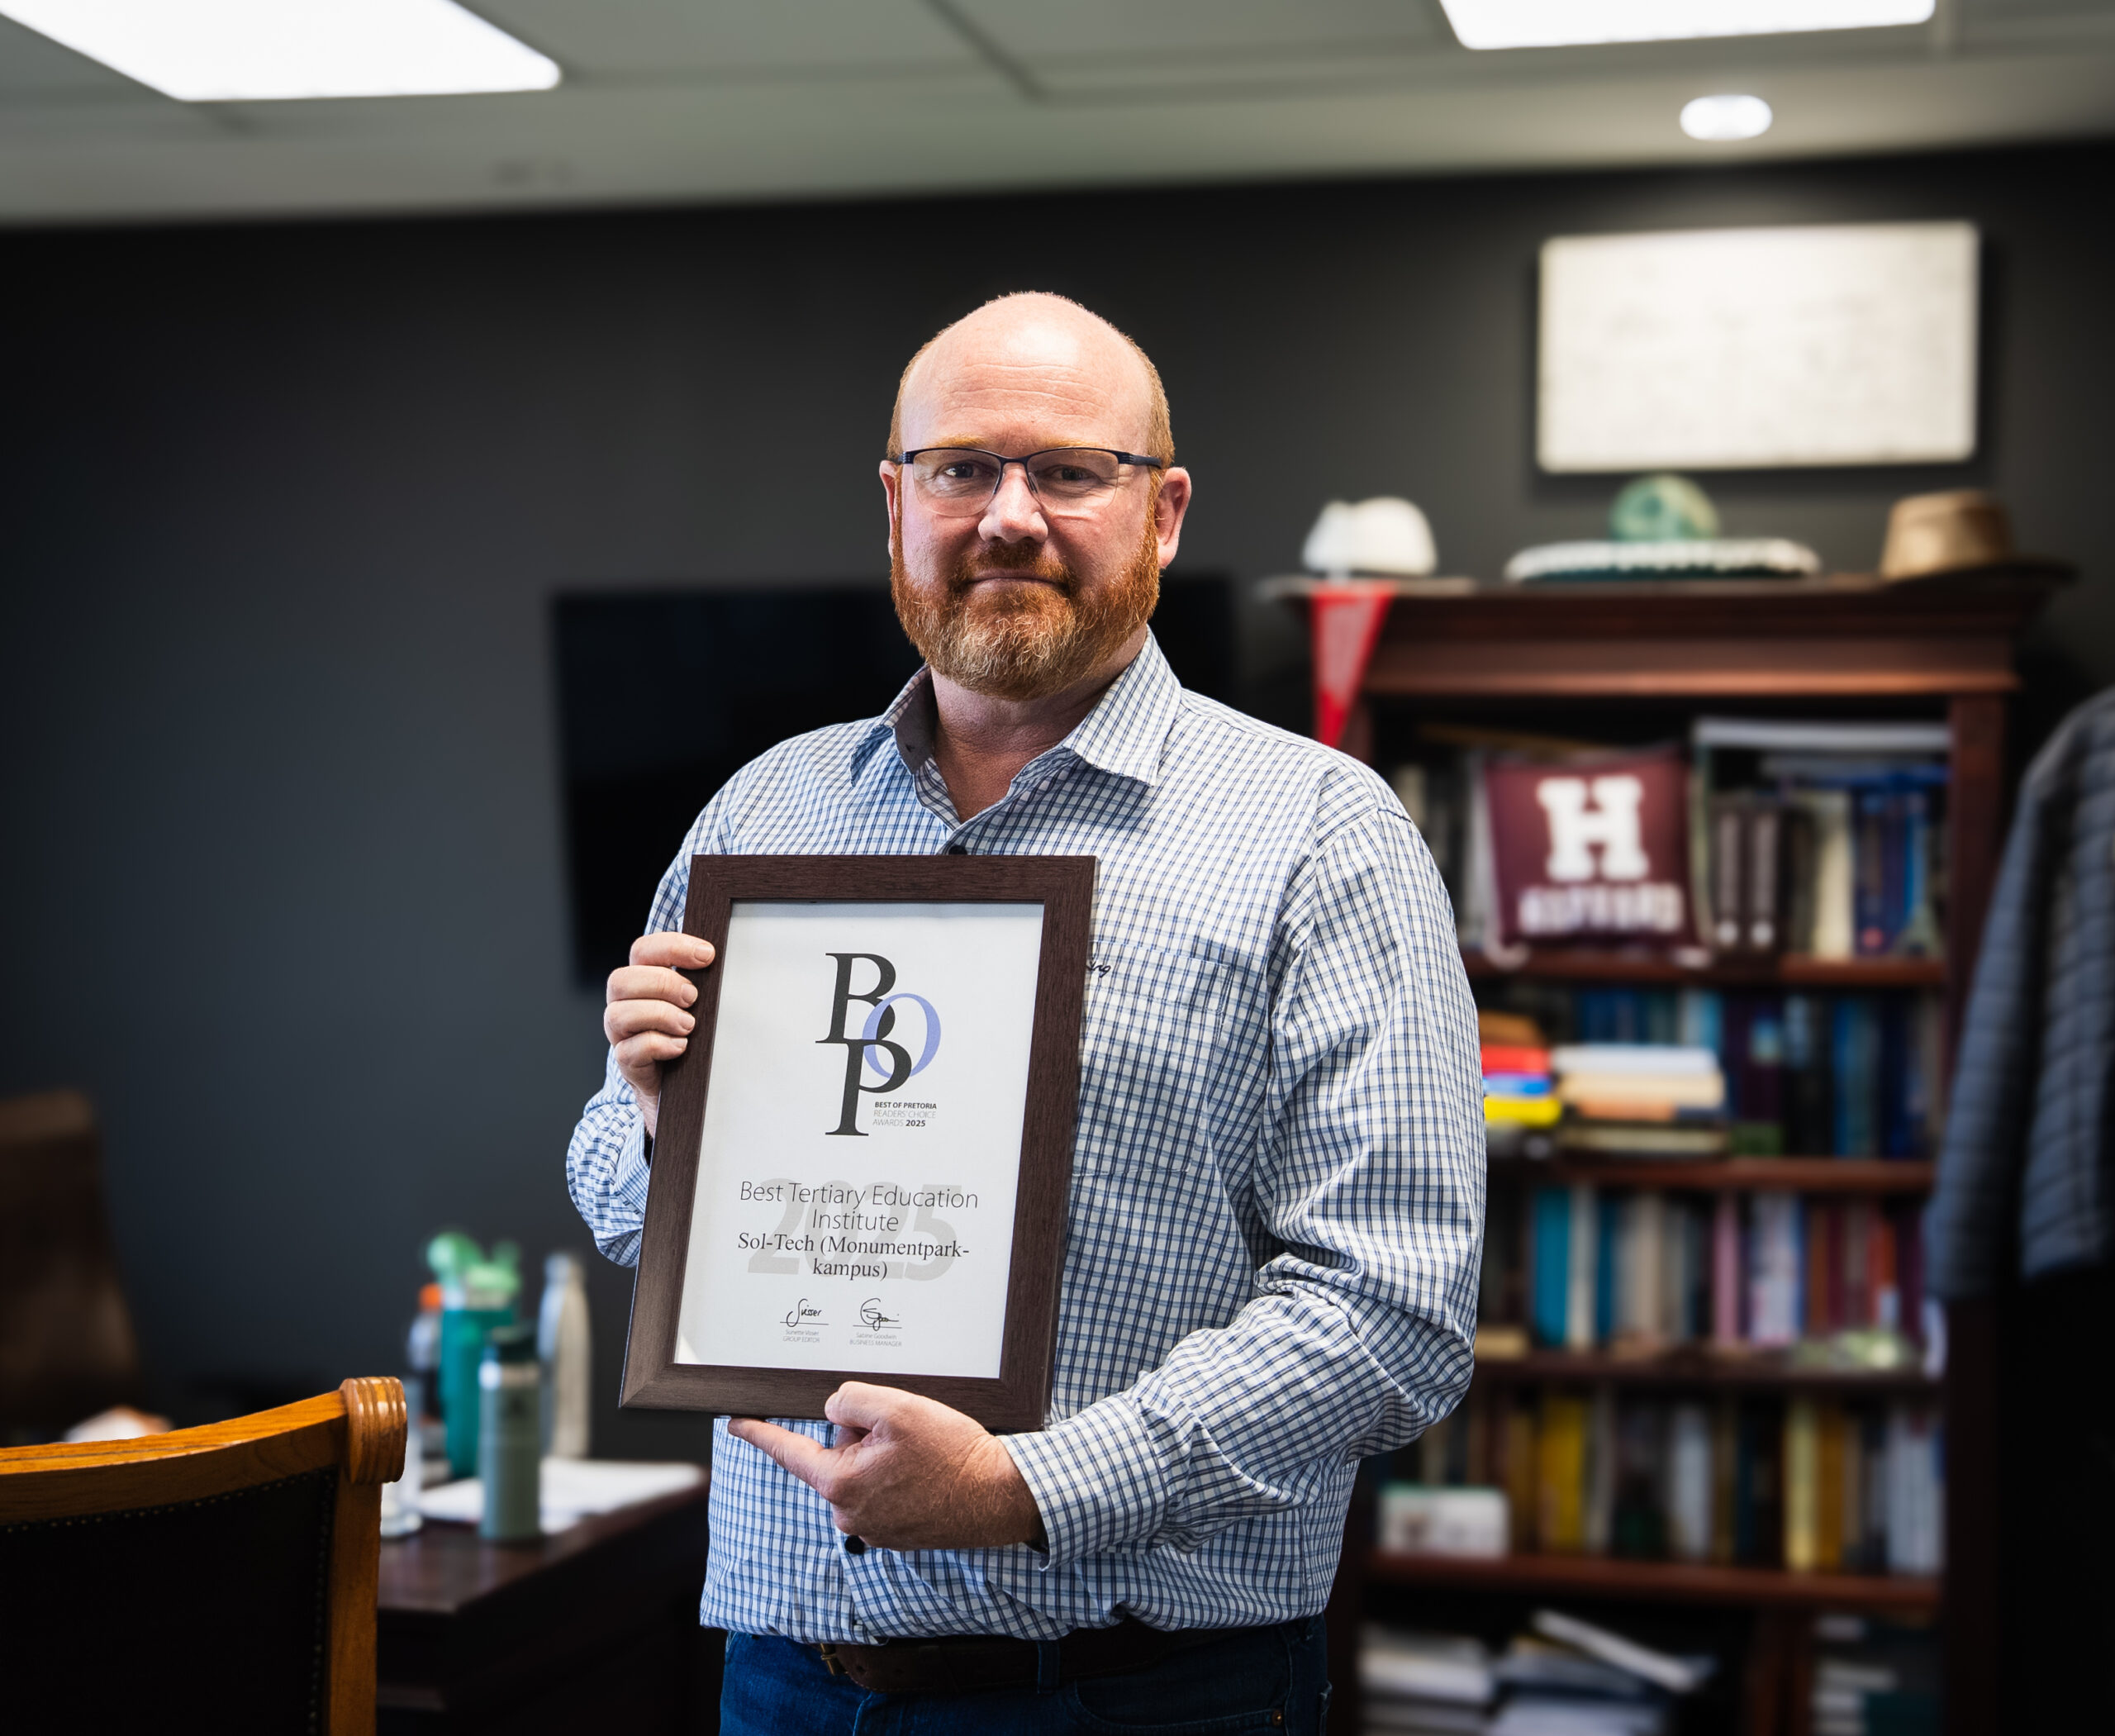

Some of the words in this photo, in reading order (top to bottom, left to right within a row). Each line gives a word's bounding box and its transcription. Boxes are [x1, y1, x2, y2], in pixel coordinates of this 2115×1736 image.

[1537, 774, 1650, 882] H
[872, 1119, 904, 1127] AWARDS
[908, 1111, 937, 1119] CHOICE
[740, 1181, 784, 1202] Best
[788, 1182, 866, 1209] Tertiary
[872, 1185, 978, 1209] Education
[812, 1209, 899, 1231] Institute
[738, 1232, 815, 1252] Sol-Tech
[820, 1235, 970, 1260] (Monumentpark-
[812, 1258, 888, 1281] kampus)
